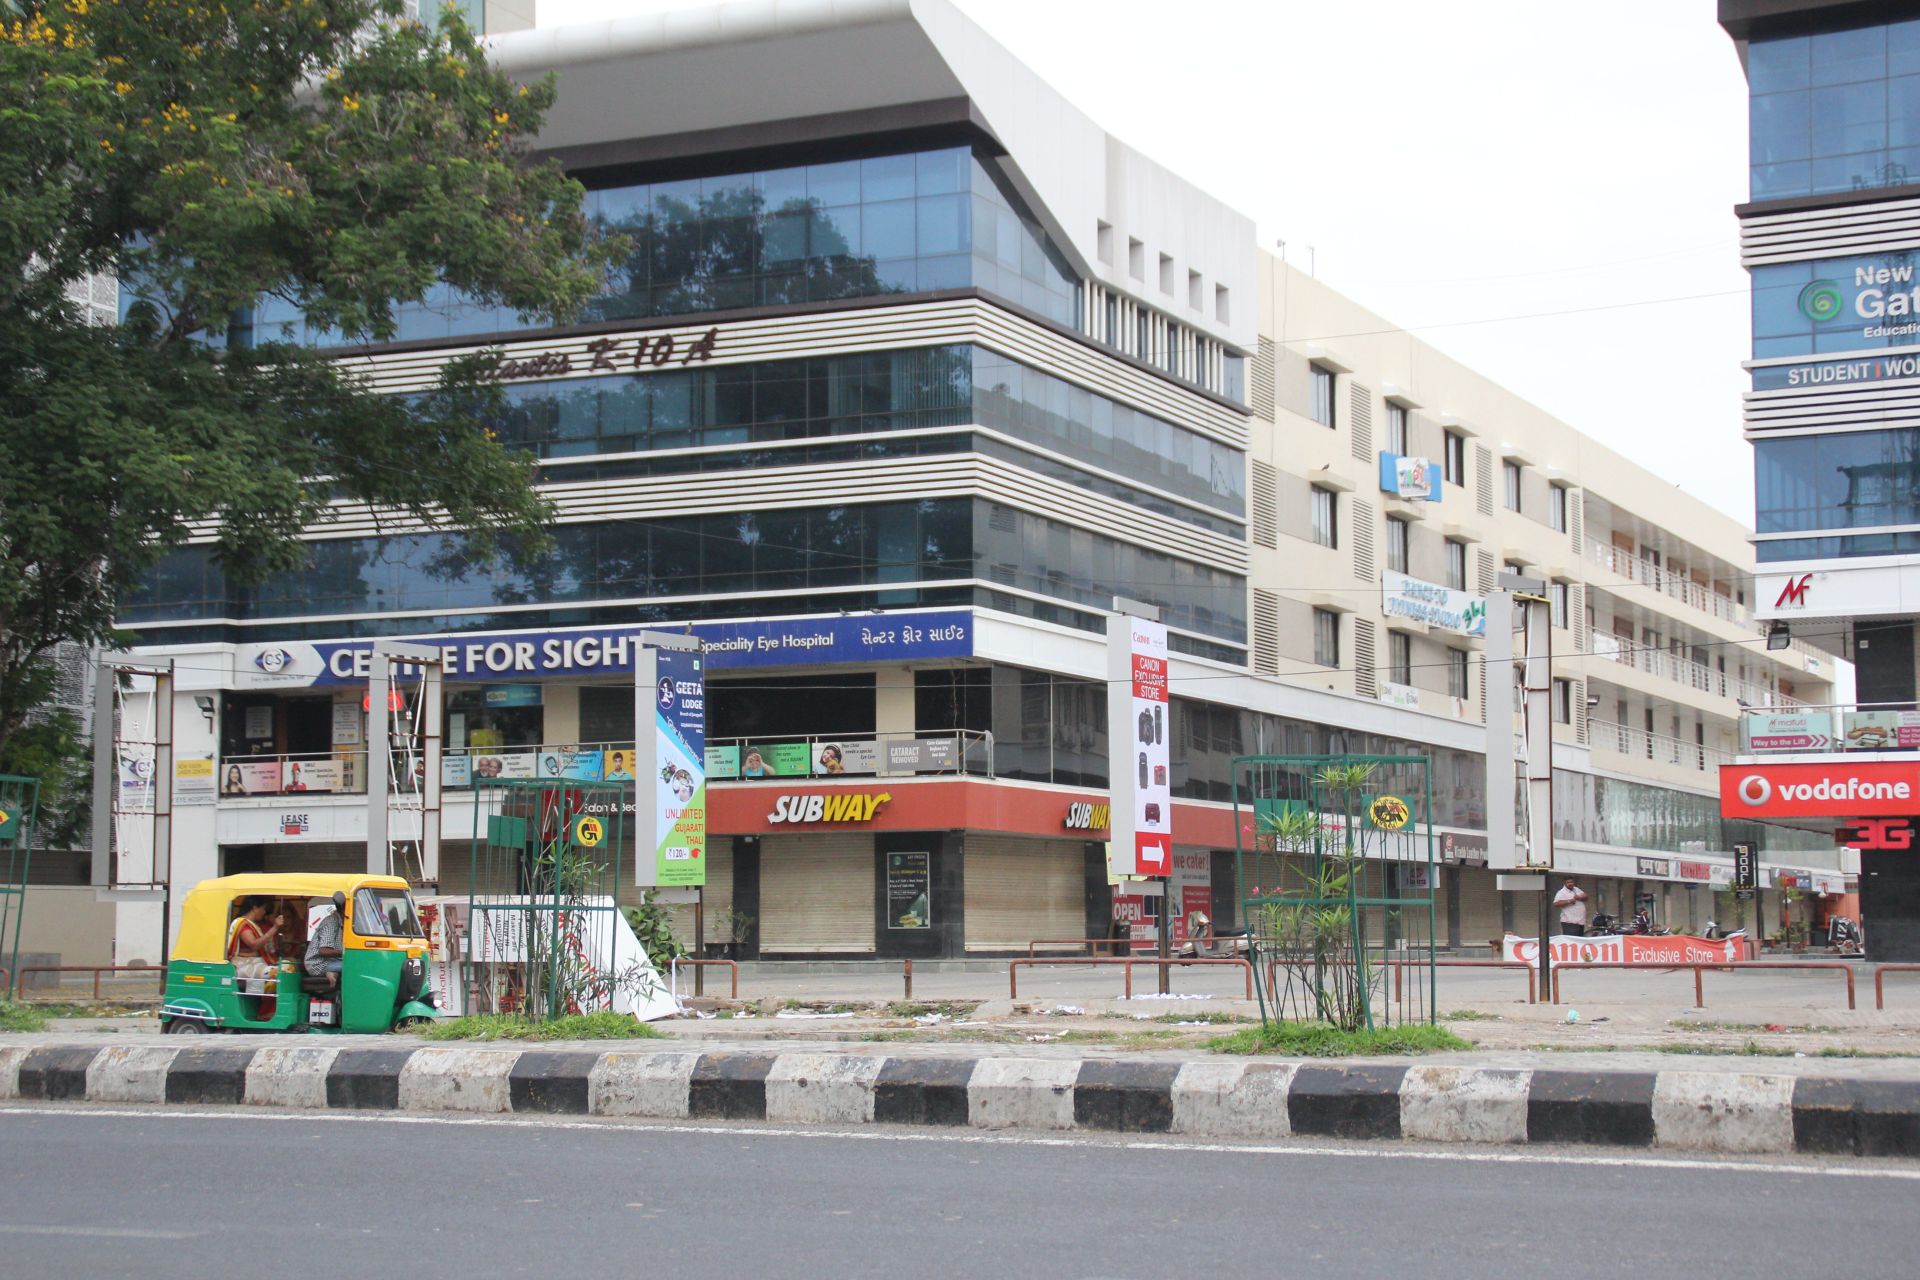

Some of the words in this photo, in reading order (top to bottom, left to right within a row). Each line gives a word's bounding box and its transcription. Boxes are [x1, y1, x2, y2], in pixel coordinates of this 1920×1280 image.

[1855, 265, 1912, 286] New
[1788, 363, 1870, 384] STUDENT
[861, 627, 895, 645] સેન્ટર
[902, 625, 922, 645] ફોર
[929, 625, 965, 641] સાઈટ
[1133, 631, 1151, 645] Canon
[701, 637, 754, 654] Speciality
[758, 636, 779, 651] Eye
[783, 632, 833, 649] Hospital
[329, 648, 457, 677] CEE
[466, 642, 535, 673] FOR
[1139, 657, 1160, 672] CANON
[1134, 670, 1165, 687] EXCLUSIVE
[675, 681, 703, 696] GEETA
[1140, 685, 1160, 699] STORE
[681, 699, 703, 709] LODGE
[891, 746, 920, 758] CATARACT
[891, 756, 919, 765] REMOVED
[1779, 778, 1910, 800] vodafone
[610, 803, 618, 812] &
[665, 808, 703, 819] UNLIMITED
[767, 792, 892, 824] SUBWAY
[281, 814, 308, 824] LEASE
[1066, 802, 1110, 829] SUBWA
[674, 823, 703, 833] GUJARATI
[1845, 819, 1911, 849] 3G
[686, 836, 703, 844] THALI
[1173, 855, 1185, 868] we
[1114, 903, 1141, 920] OPEN
[1513, 941, 1619, 962] Canon
[1632, 946, 1680, 962] Exclusive
[1686, 946, 1713, 962] Store
